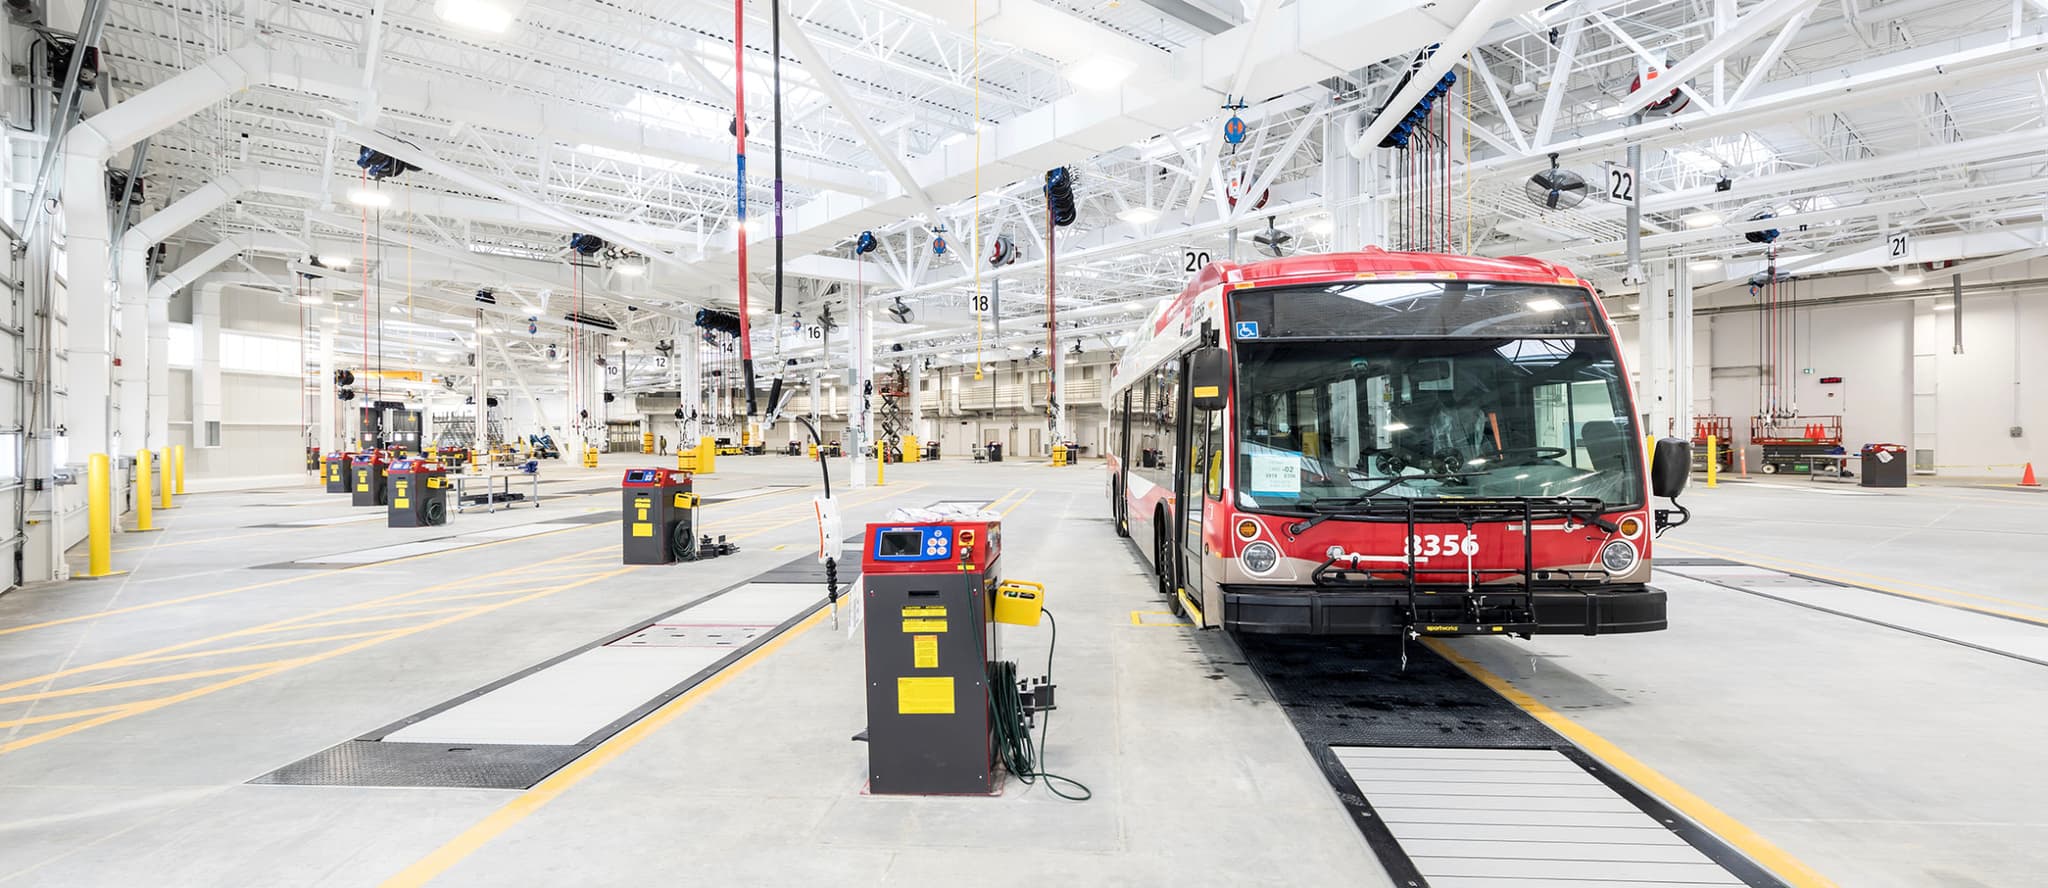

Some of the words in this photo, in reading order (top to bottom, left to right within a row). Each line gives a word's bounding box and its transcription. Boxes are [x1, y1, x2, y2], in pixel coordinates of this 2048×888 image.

[1612, 170, 1633, 201] 22
[1892, 236, 1906, 257] 21
[1185, 252, 1210, 272] 20
[972, 295, 988, 312] 18
[807, 326, 821, 339] 16
[721, 342, 734, 354] 14
[655, 357, 666, 367] 12
[607, 366, 618, 376] 10
[1404, 534, 1479, 557] 8356
